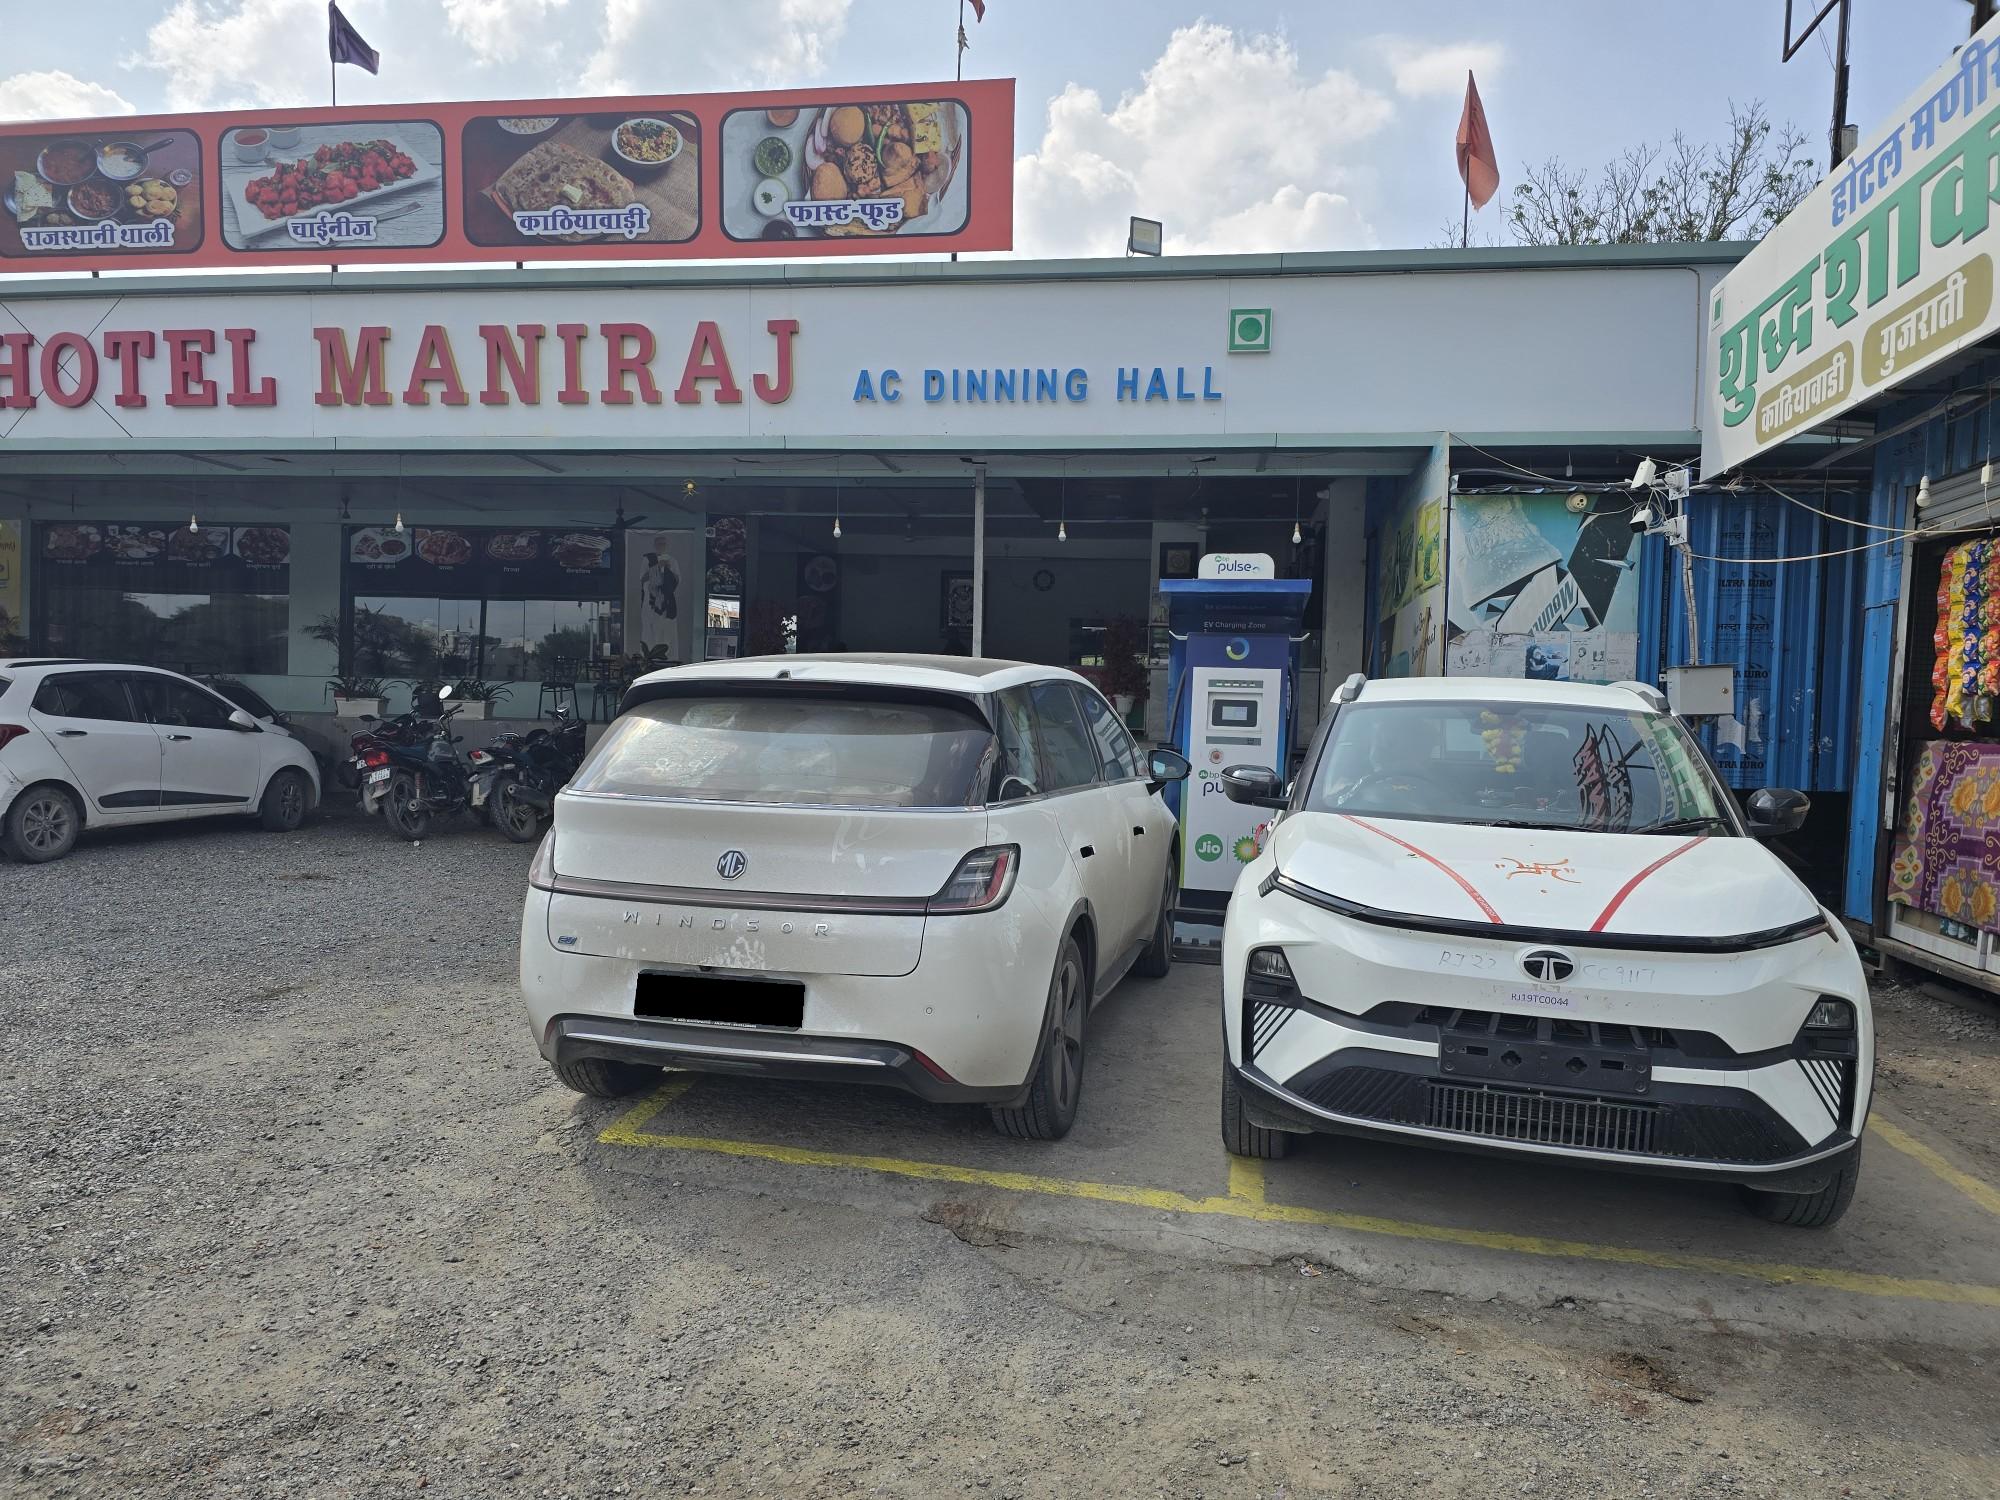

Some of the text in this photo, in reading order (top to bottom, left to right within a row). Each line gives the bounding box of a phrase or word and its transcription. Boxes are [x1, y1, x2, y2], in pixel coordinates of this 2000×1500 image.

[1831, 122, 1906, 227] होटल
[787, 202, 901, 226] फास्ट-फूड
[24, 222, 171, 247] राजस्थानी थाली
[291, 215, 374, 241] चाईनीज
[1880, 271, 1968, 377] गुजराती
[0, 319, 800, 408] HOTEL MANIRAJ
[853, 366, 1222, 402] AC DINNING HALL
[1217, 560, 1252, 575] pulse
[1209, 770, 1220, 781] bp
[1198, 841, 1221, 854] Jio
[717, 851, 746, 878] MG
[623, 911, 832, 937] WINDSOR
[1511, 992, 1569, 1007] RJ19TC0044
